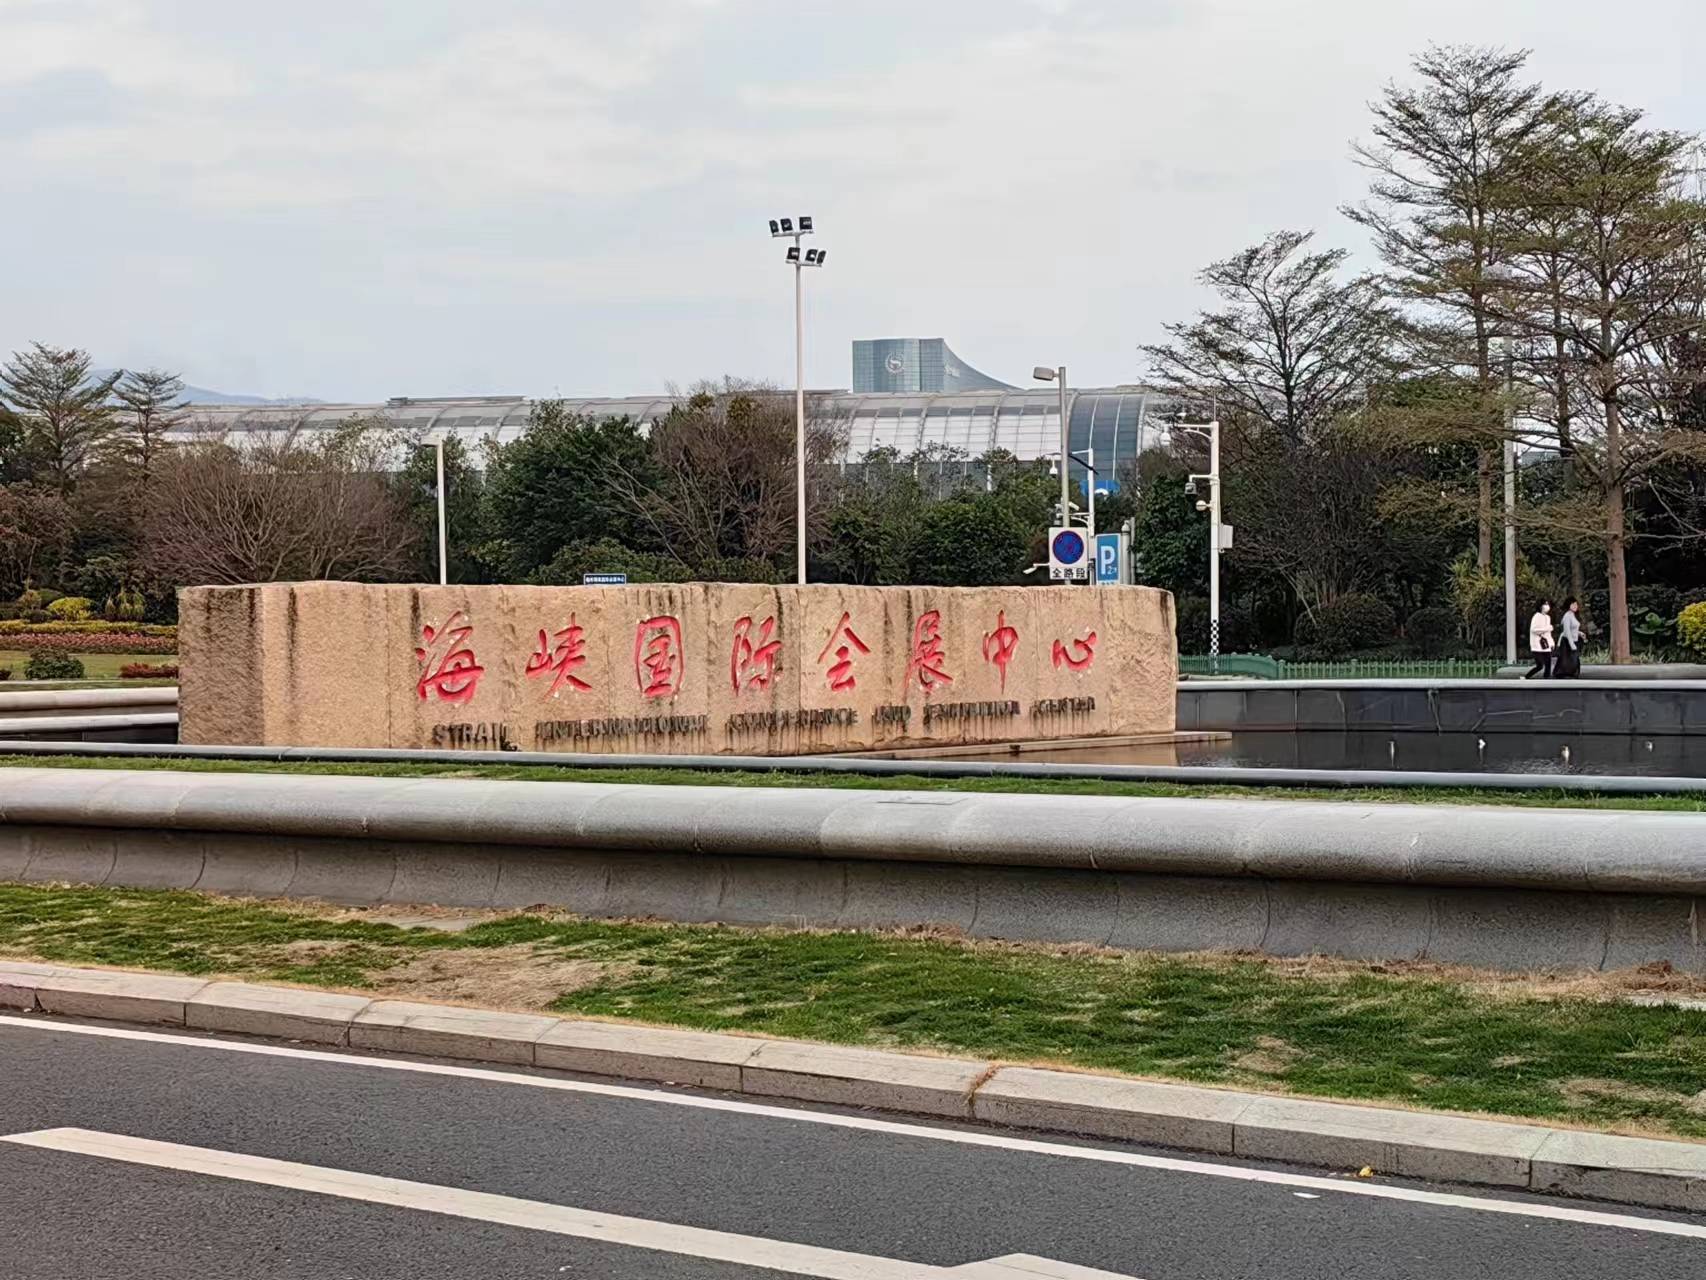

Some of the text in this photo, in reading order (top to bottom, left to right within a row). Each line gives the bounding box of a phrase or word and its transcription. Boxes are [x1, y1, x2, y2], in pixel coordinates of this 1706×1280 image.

[1052, 568, 1086, 578] 全路段
[415, 610, 1097, 703] 海峡国际会展中心
